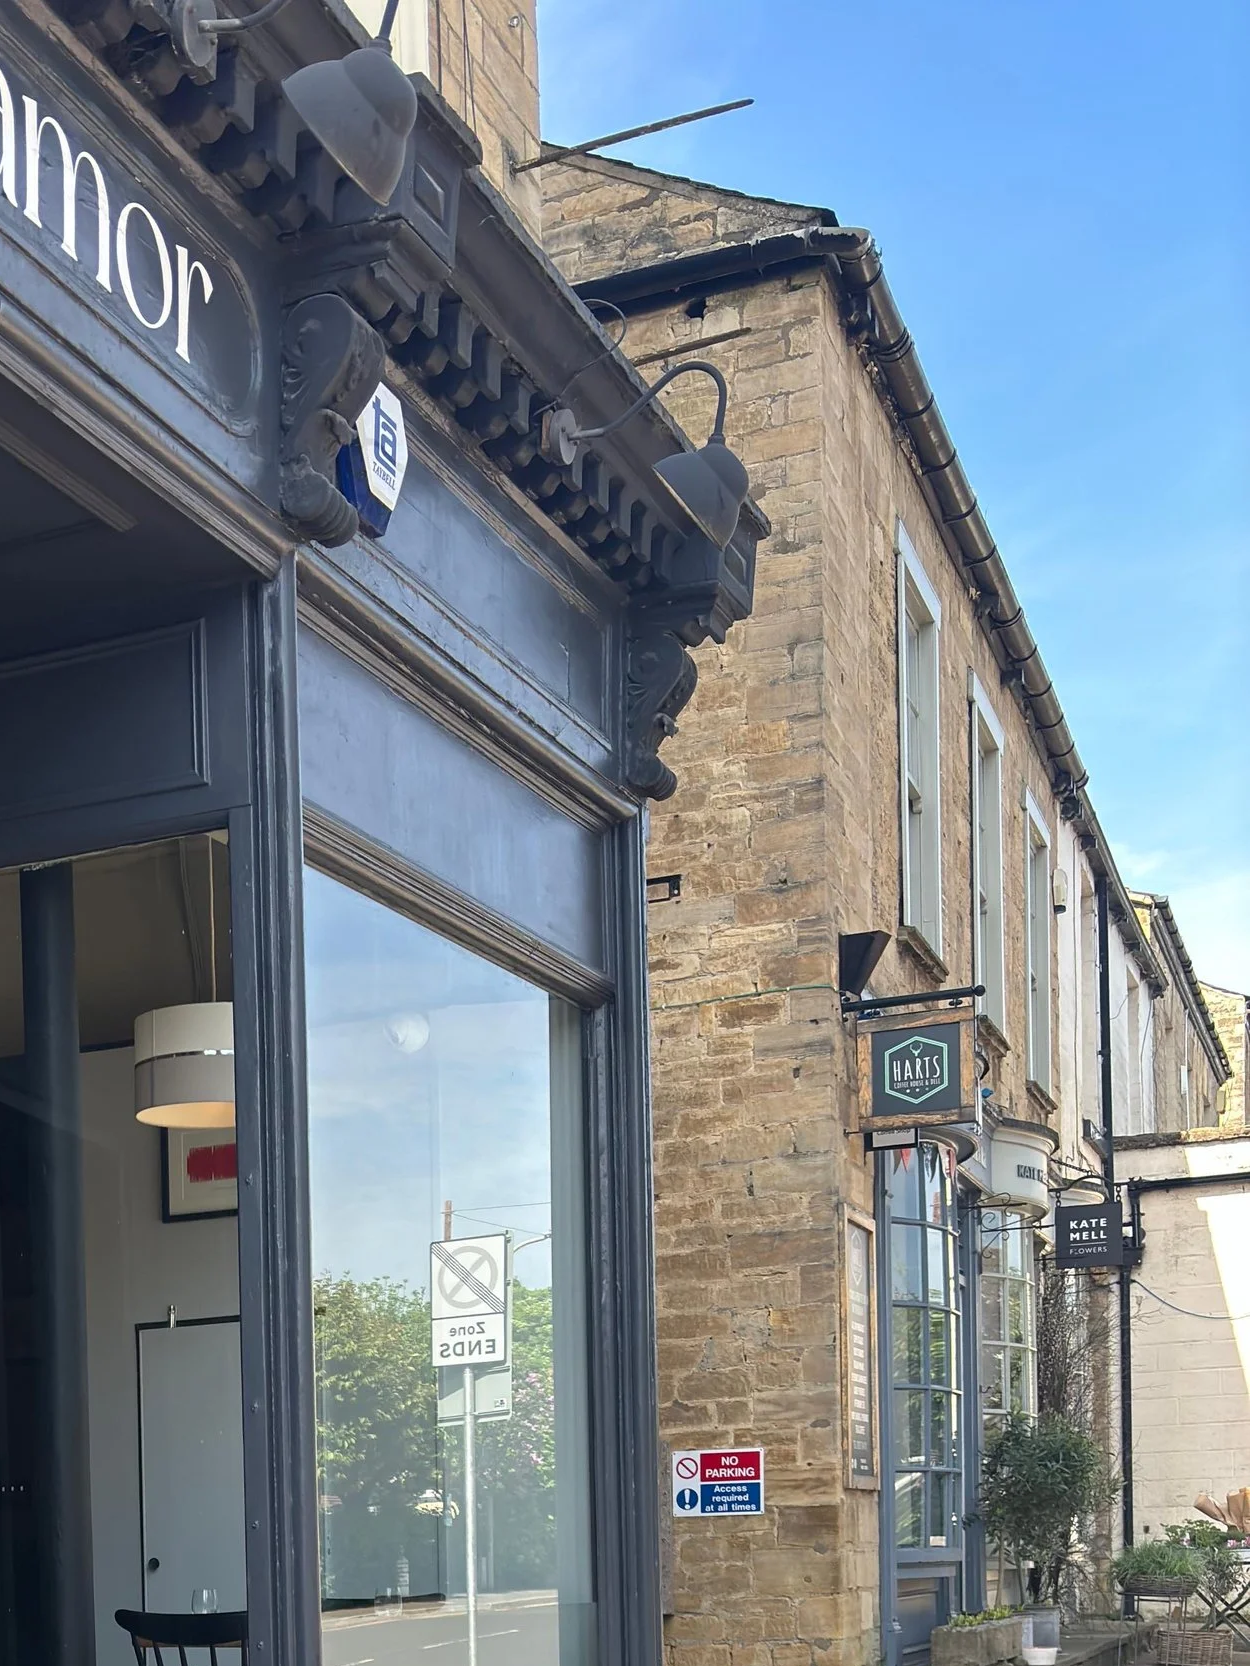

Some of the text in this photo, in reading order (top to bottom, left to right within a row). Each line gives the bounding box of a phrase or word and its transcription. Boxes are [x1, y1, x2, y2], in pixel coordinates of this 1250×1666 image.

[372, 461, 396, 491] TAYBELL
[893, 1055, 941, 1082] HARTS
[1070, 1218, 1108, 1229] KATE
[1070, 1230, 1108, 1241] MELL
[1070, 1246, 1108, 1255] FLOWERS
[721, 1456, 739, 1466] NO
[705, 1467, 755, 1478] PARKING
[714, 1485, 748, 1493] Access
[712, 1494, 749, 1504] required
[717, 1504, 728, 1512] all
[731, 1503, 757, 1512] times
